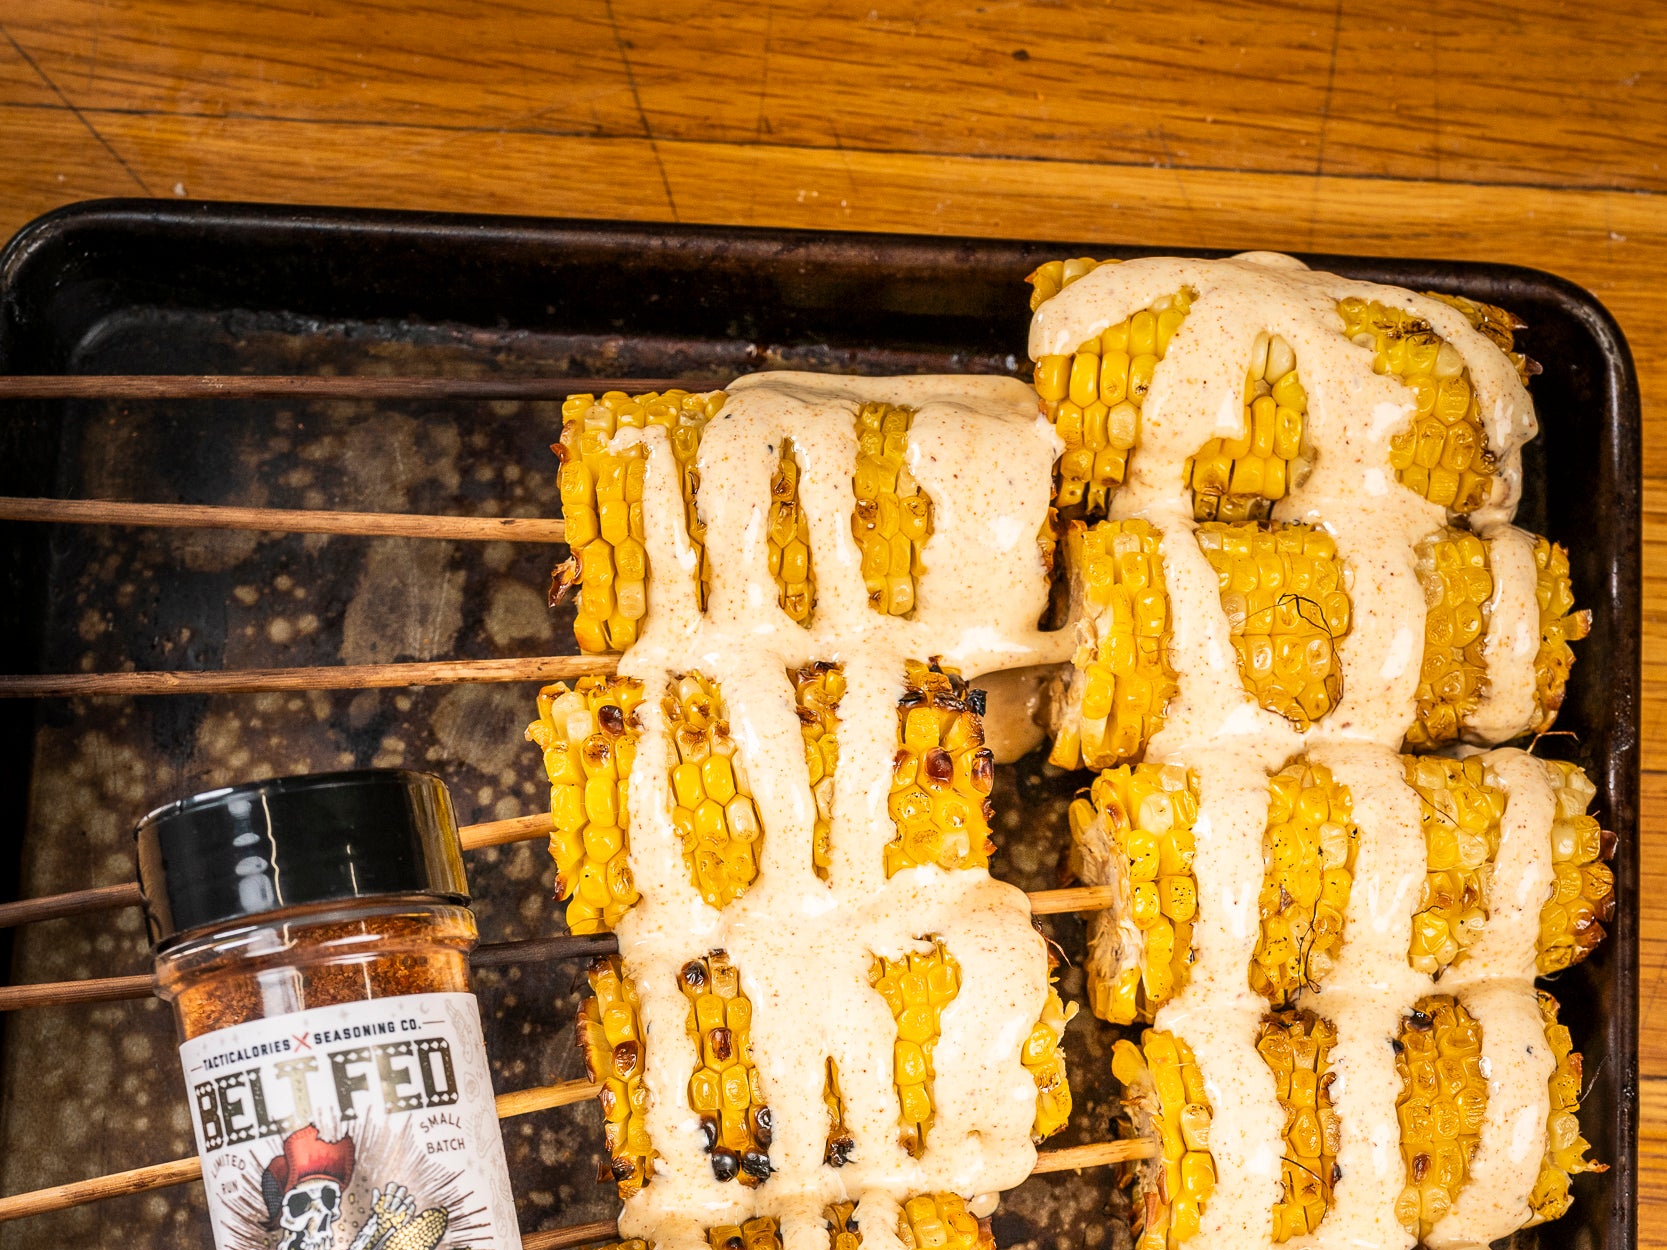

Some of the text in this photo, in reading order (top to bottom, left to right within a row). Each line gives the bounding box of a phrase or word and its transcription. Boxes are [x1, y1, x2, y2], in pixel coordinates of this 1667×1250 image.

[203, 1018, 422, 1071] TACTICALORIES SEASONING CO.
[194, 1036, 459, 1153] BELT FED
[420, 1112, 463, 1131] SMALL
[427, 1137, 466, 1155] BATCH
